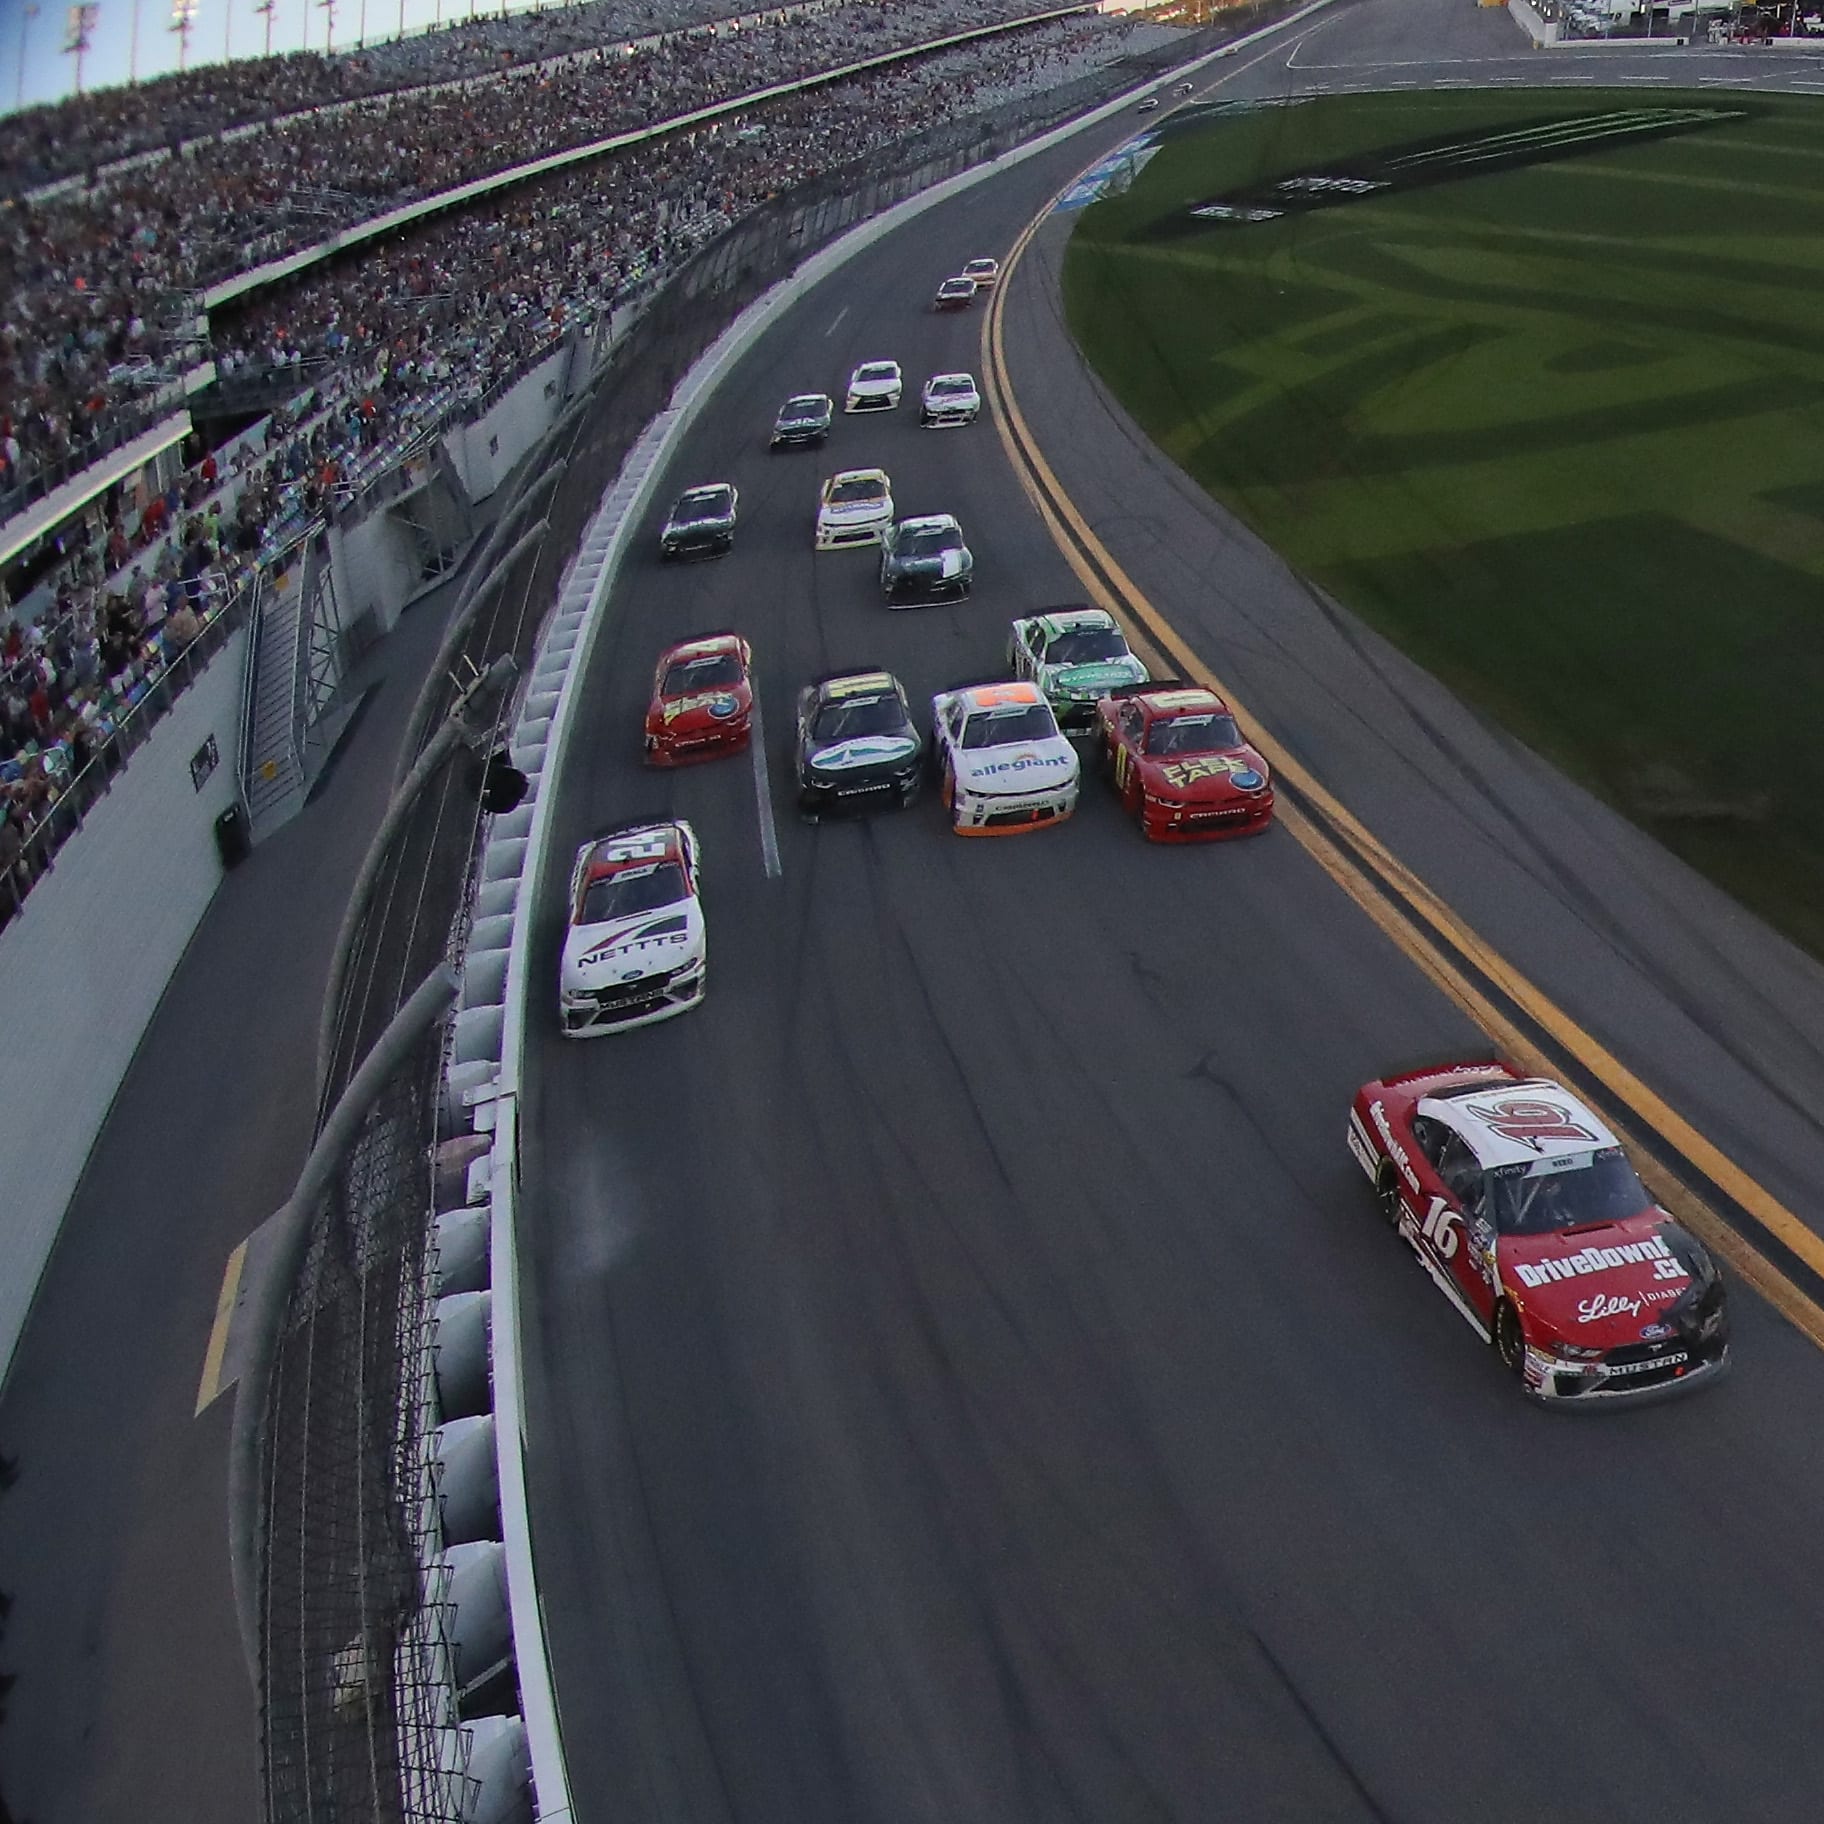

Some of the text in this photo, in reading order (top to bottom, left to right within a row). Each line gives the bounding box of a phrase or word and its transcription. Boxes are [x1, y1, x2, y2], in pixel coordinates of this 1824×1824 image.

[970, 753, 1070, 779] allegiant
[577, 933, 688, 968] NETTTS
[1466, 1099, 1599, 1152] 16
[1421, 1195, 1464, 1260] 16
[1577, 1293, 1642, 1324] Lilly
